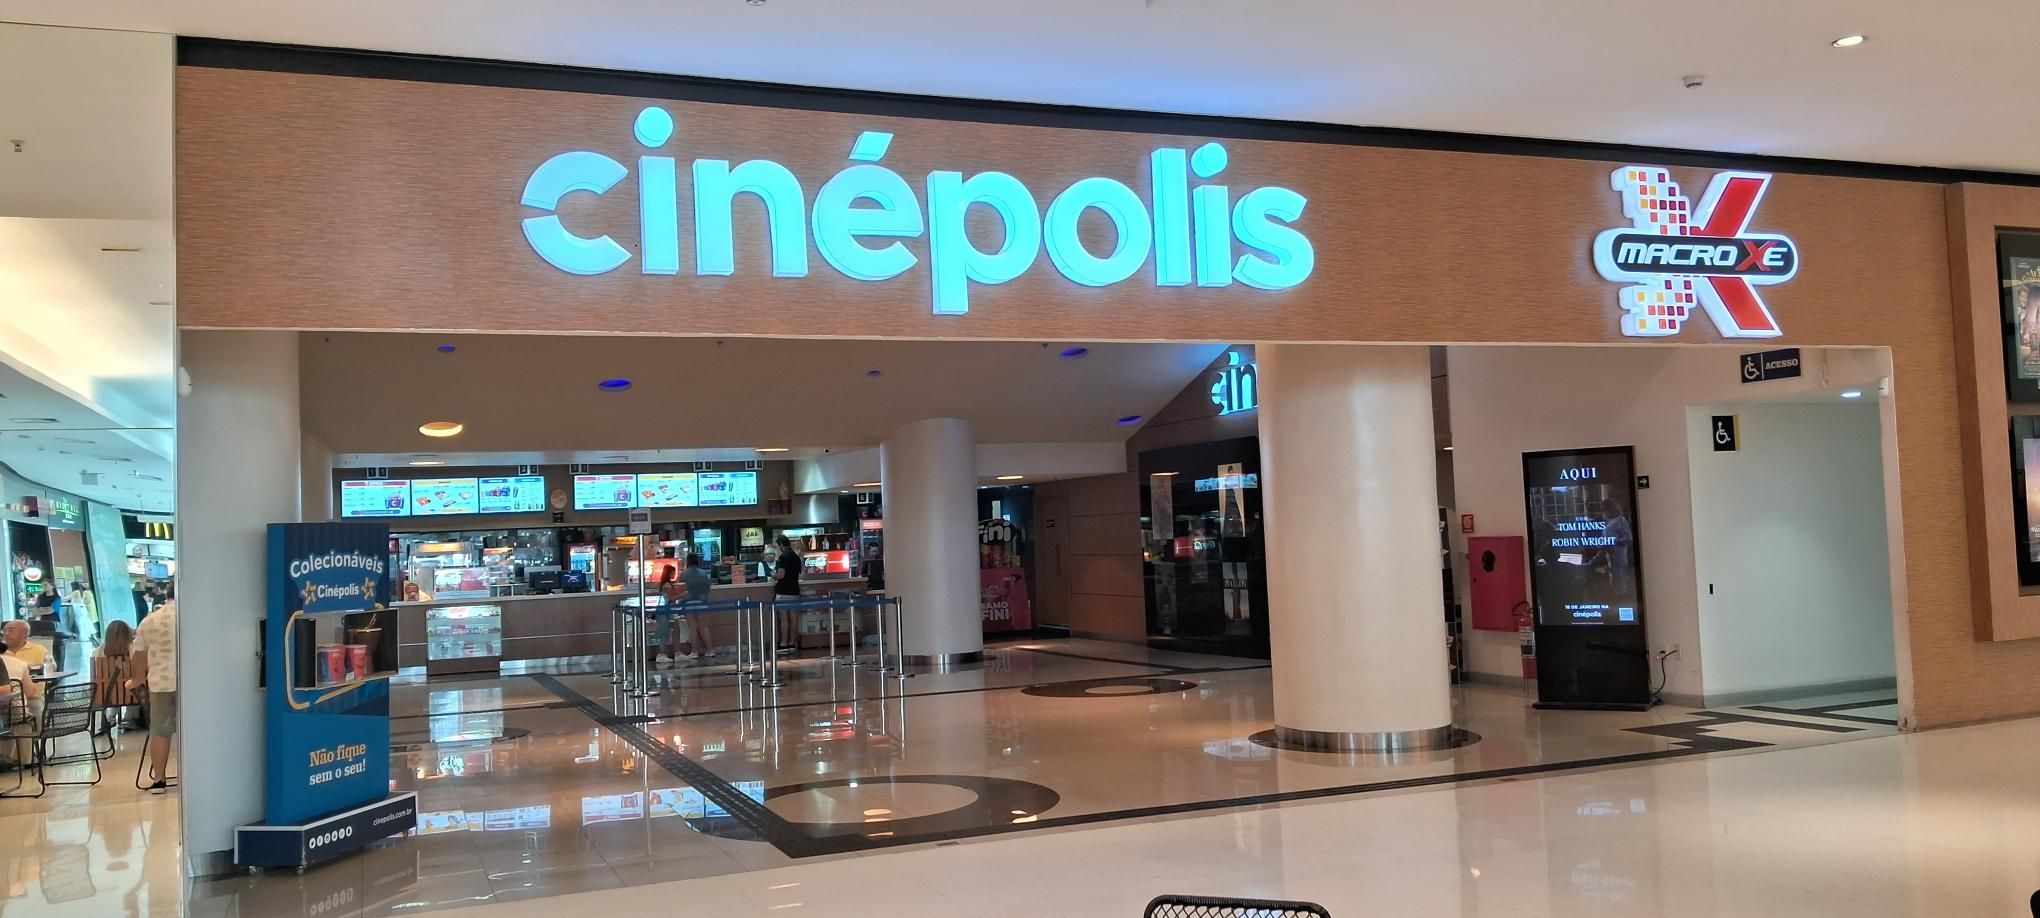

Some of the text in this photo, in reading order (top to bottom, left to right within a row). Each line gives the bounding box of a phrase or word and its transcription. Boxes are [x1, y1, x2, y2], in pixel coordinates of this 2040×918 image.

[521, 107, 1314, 315] cinépolis
[1765, 359, 1798, 370] ACESSO
[1560, 467, 1596, 480] AQUI
[1558, 522, 1606, 531] TOM HANKS
[1552, 537, 1616, 547] ROBIN WRIGHT
[290, 550, 383, 578] Colecionáveis
[317, 583, 360, 599] Cinépolis
[309, 743, 366, 767] Não fique
[309, 758, 366, 785] sem o seu!
